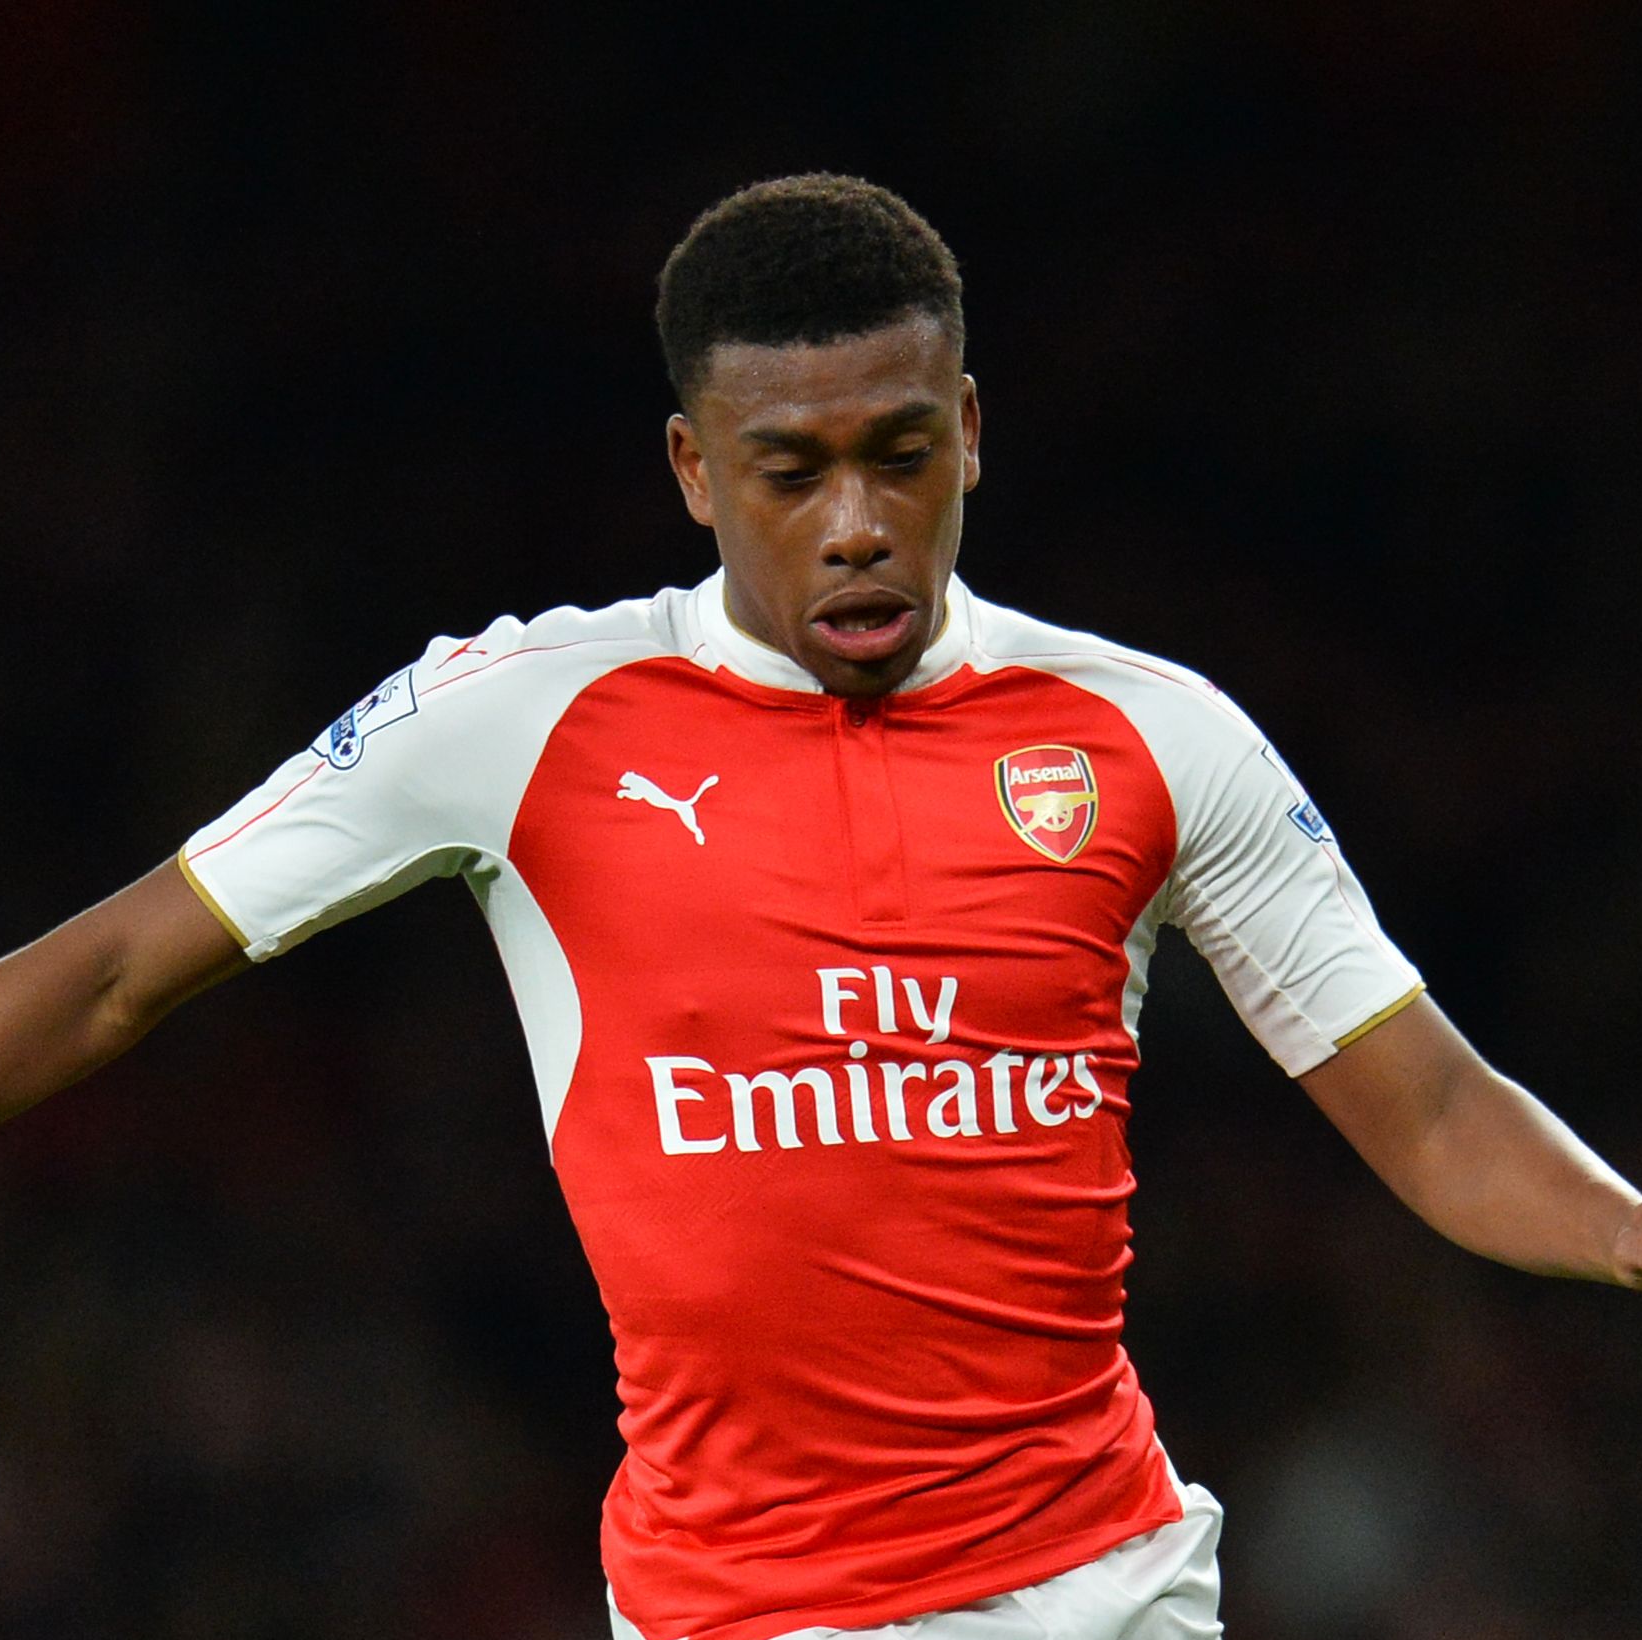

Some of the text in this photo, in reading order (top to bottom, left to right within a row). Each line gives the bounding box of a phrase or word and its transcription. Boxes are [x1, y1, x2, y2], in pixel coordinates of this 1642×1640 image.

[1010, 761, 1082, 786] Arsenal
[815, 965, 958, 1045] Fly
[643, 1041, 1104, 1156] Emirates
